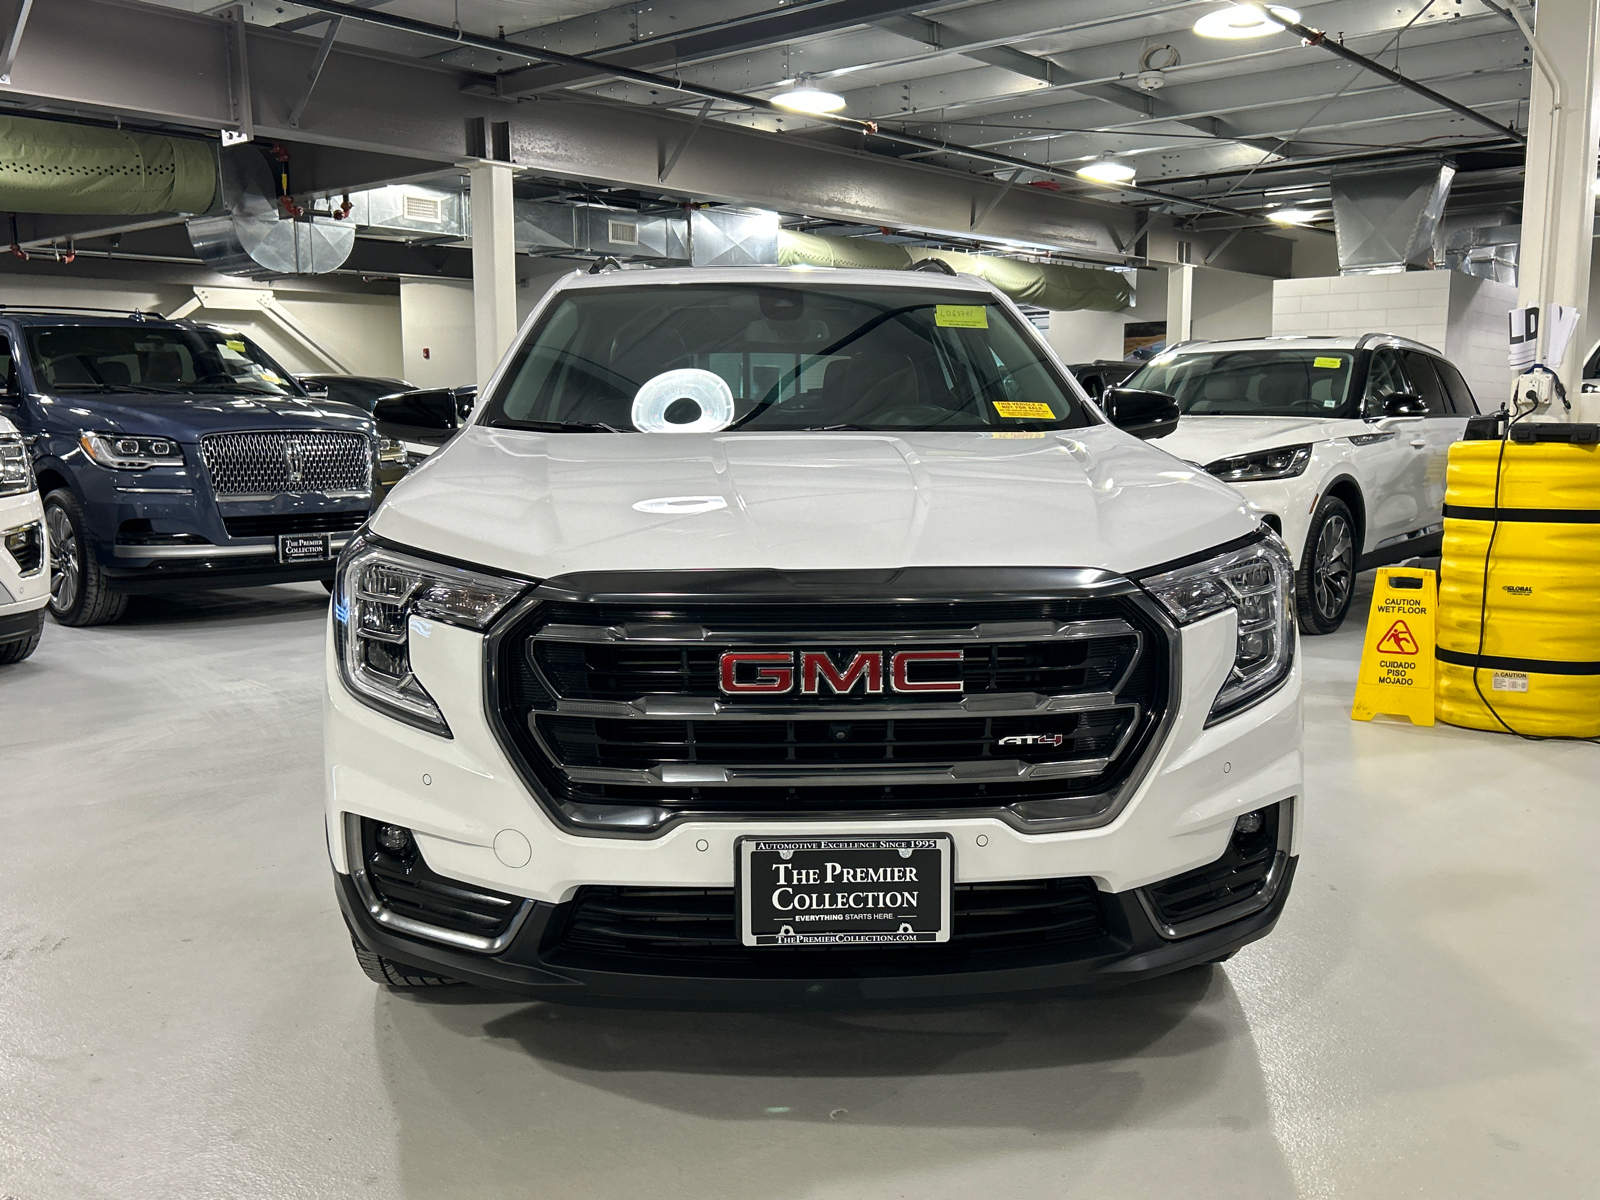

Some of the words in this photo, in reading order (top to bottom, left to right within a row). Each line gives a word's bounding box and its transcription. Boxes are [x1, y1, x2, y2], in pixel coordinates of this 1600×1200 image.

[1384, 598, 1420, 606] CAUTION
[1380, 660, 1416, 669] CUIDADO
[718, 650, 964, 695] GMC
[1387, 669, 1406, 677] PISO
[1378, 676, 1413, 685] MOJADO
[998, 734, 1063, 746] AT4
[758, 842, 819, 850] AUTOMOTIVE
[820, 841, 878, 849] EXCELLENCE
[910, 840, 935, 848] 1995
[772, 863, 820, 885] THE
[824, 862, 918, 884] PREMIER
[772, 887, 919, 911] COLLECTION
[776, 934, 917, 944] THEPREMIERCOLLECTION.COM
